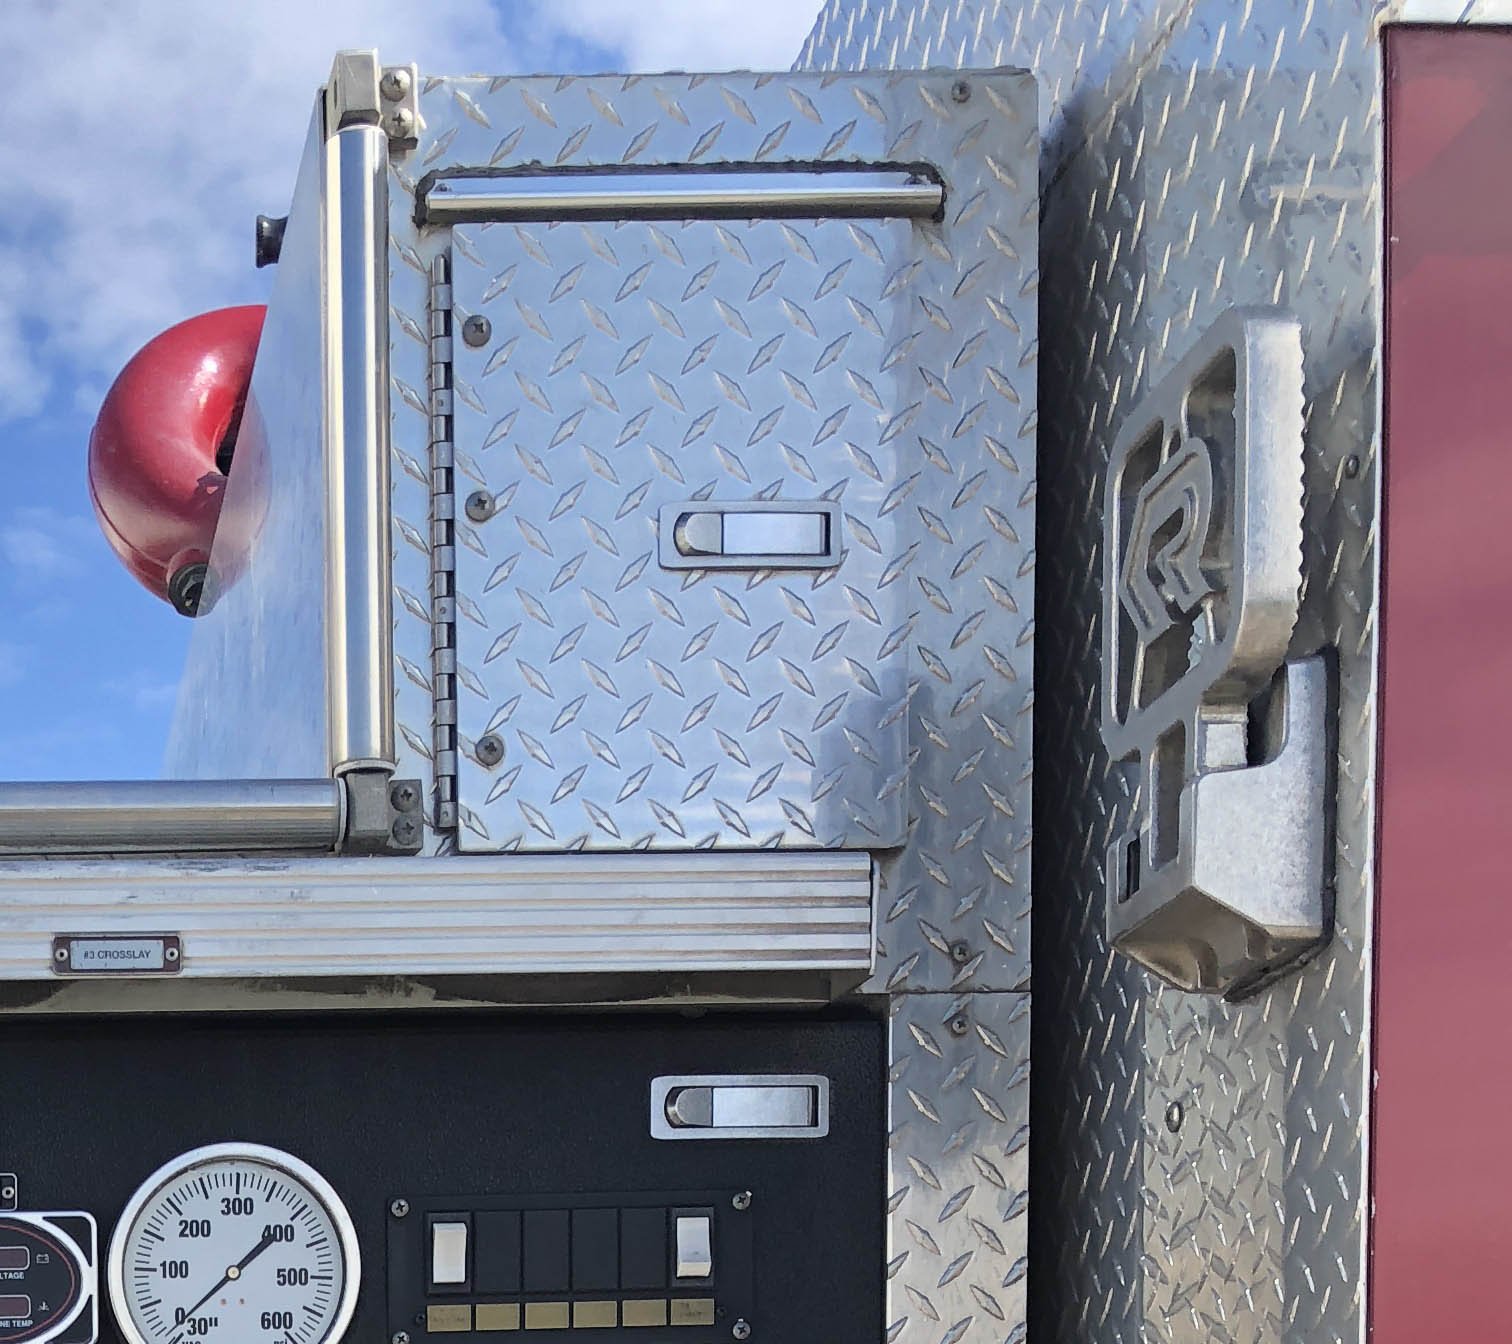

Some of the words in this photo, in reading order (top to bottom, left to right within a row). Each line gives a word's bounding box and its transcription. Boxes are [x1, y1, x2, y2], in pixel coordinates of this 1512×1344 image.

[84, 950, 95, 960] #3
[97, 949, 151, 960] CROSSLAY
[221, 1198, 254, 1216] 300
[179, 1220, 211, 1238] 200
[262, 1225, 294, 1242] 400
[160, 1261, 188, 1279] 100
[277, 1268, 309, 1286] 500
[261, 1312, 293, 1330] 600
